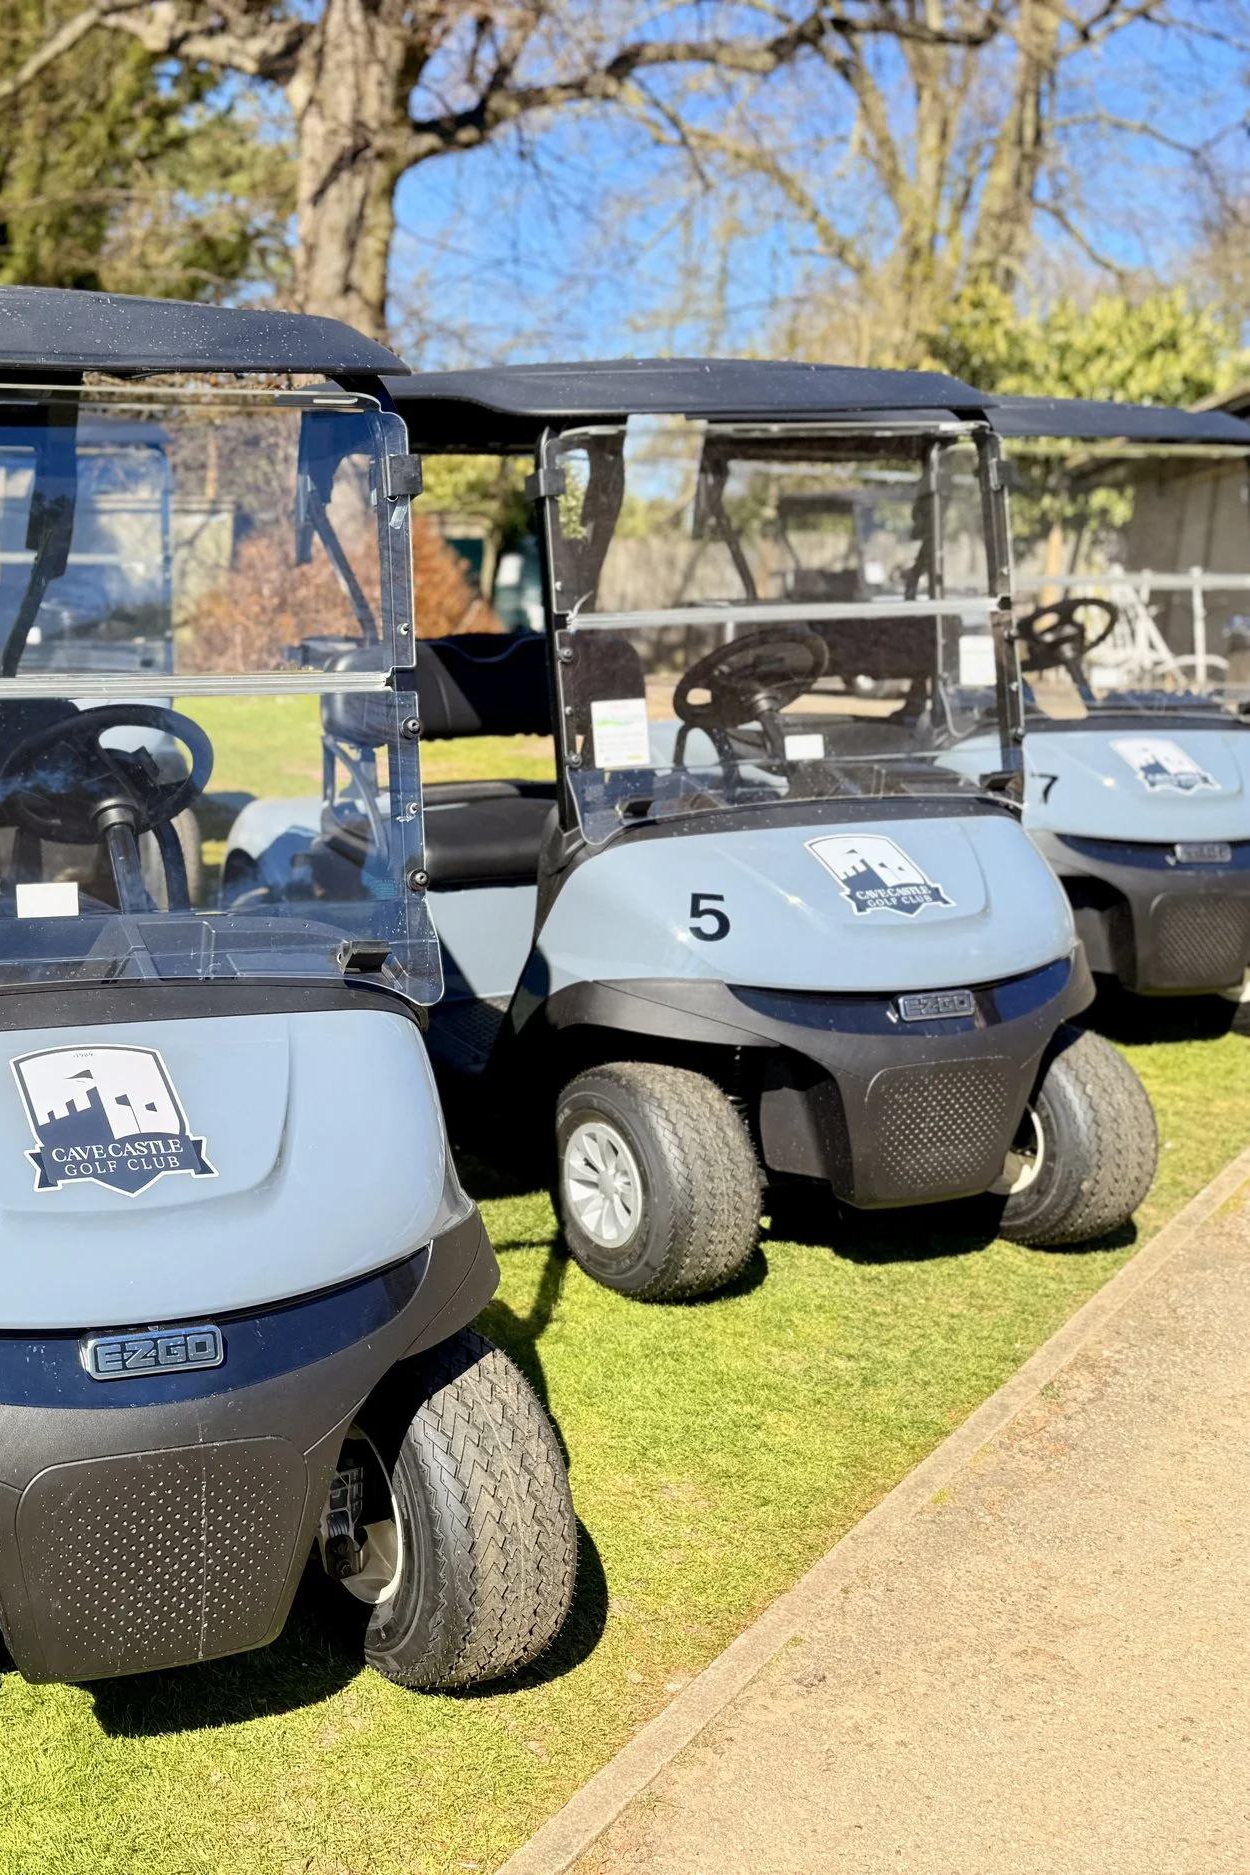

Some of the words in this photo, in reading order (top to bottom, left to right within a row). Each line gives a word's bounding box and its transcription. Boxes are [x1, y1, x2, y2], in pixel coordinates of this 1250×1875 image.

[1031, 773, 1059, 804] 7
[856, 889, 888, 900] CAVE
[888, 886, 932, 897] CASTLE
[867, 897, 898, 907] GOLF
[901, 895, 933, 904] CLUB
[689, 892, 731, 942] 5
[51, 1145, 106, 1163] CAVE
[108, 1139, 184, 1157] CASTLE
[64, 1161, 117, 1176] GOLF
[127, 1156, 180, 1171] CLUB
[96, 1333, 216, 1372] EZGO
